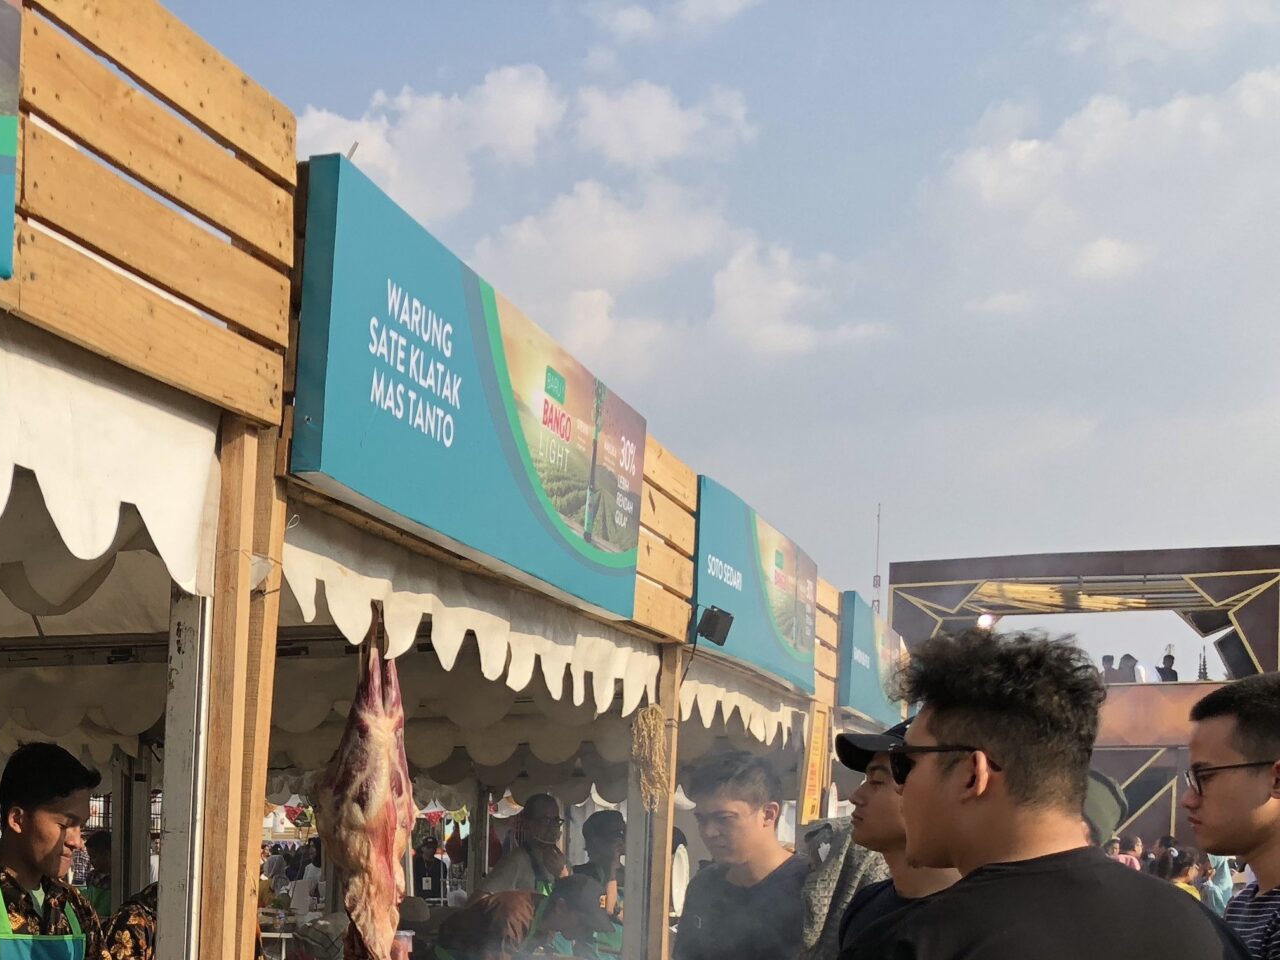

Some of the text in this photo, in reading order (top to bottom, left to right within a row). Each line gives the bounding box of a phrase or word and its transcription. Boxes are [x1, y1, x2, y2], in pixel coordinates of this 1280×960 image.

[387, 278, 453, 358] WARUNG
[368, 316, 462, 410] SATE KLATAK
[370, 367, 454, 448] MAS TANTO
[542, 398, 572, 442] BANGO
[538, 432, 570, 471] LIGHT
[619, 436, 637, 477] 30%
[707, 553, 723, 580] SOTO
